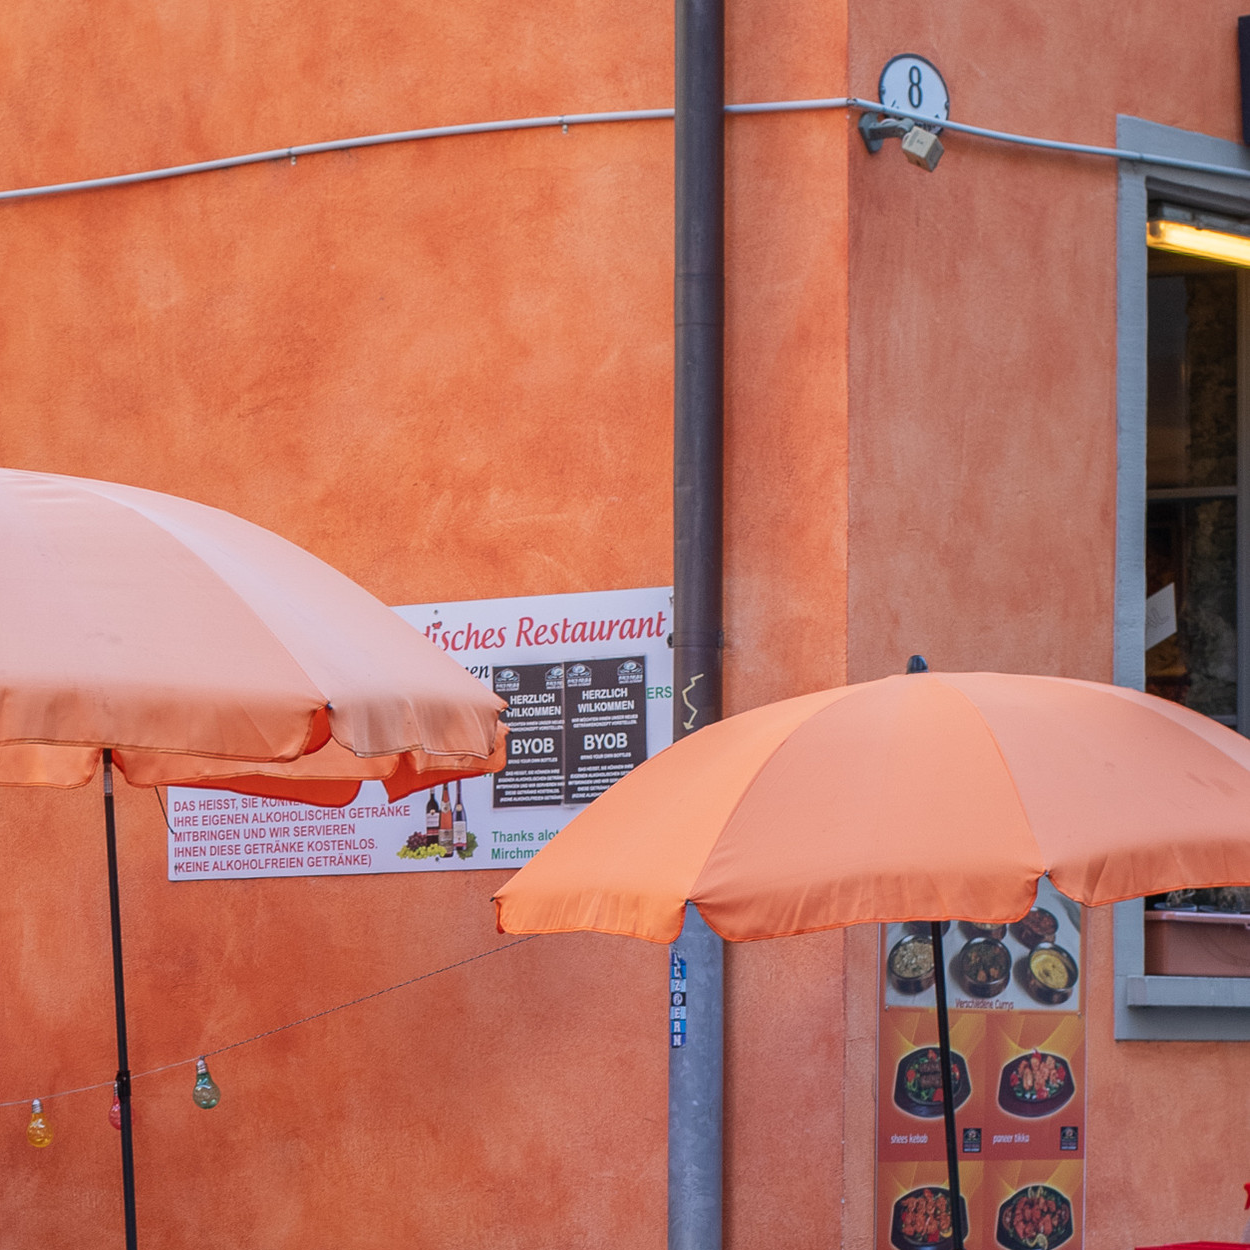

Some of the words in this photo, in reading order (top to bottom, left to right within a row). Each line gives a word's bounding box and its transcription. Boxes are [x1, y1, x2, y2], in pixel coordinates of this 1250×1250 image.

[908, 65, 923, 108] 8
[516, 611, 667, 648] Restaurant
[510, 693, 555, 705] HERZLICH
[582, 687, 628, 700] HERZLICH
[577, 700, 635, 713] WILKOMMEN
[512, 737, 554, 755] BYOB
[584, 732, 628, 750] BYOB
[174, 801, 195, 812] DAS
[199, 799, 238, 811] HEISST,
[241, 797, 258, 808] SIE
[174, 816, 198, 827] IHRE
[202, 813, 249, 826] EIGENEN
[252, 809, 345, 823] ALKOHOLISCHEN
[349, 804, 410, 818] GETRÄNKE
[174, 830, 240, 842] MITBRINGEN
[244, 828, 266, 839] UND
[269, 827, 289, 838] WIR
[293, 823, 356, 837] SERVIEREN
[491, 830, 534, 843] Thanks
[174, 846, 206, 857] IHNEN
[210, 844, 241, 856] DIESE
[244, 840, 304, 855] GETRÄNKE
[307, 838, 378, 852] KOSTENLOS.
[491, 847, 540, 860] Mirchm
[174, 861, 209, 875] (KEINE
[212, 857, 304, 871] ALKOHOLFREIEN
[307, 853, 372, 868] GETRÄNKE)
